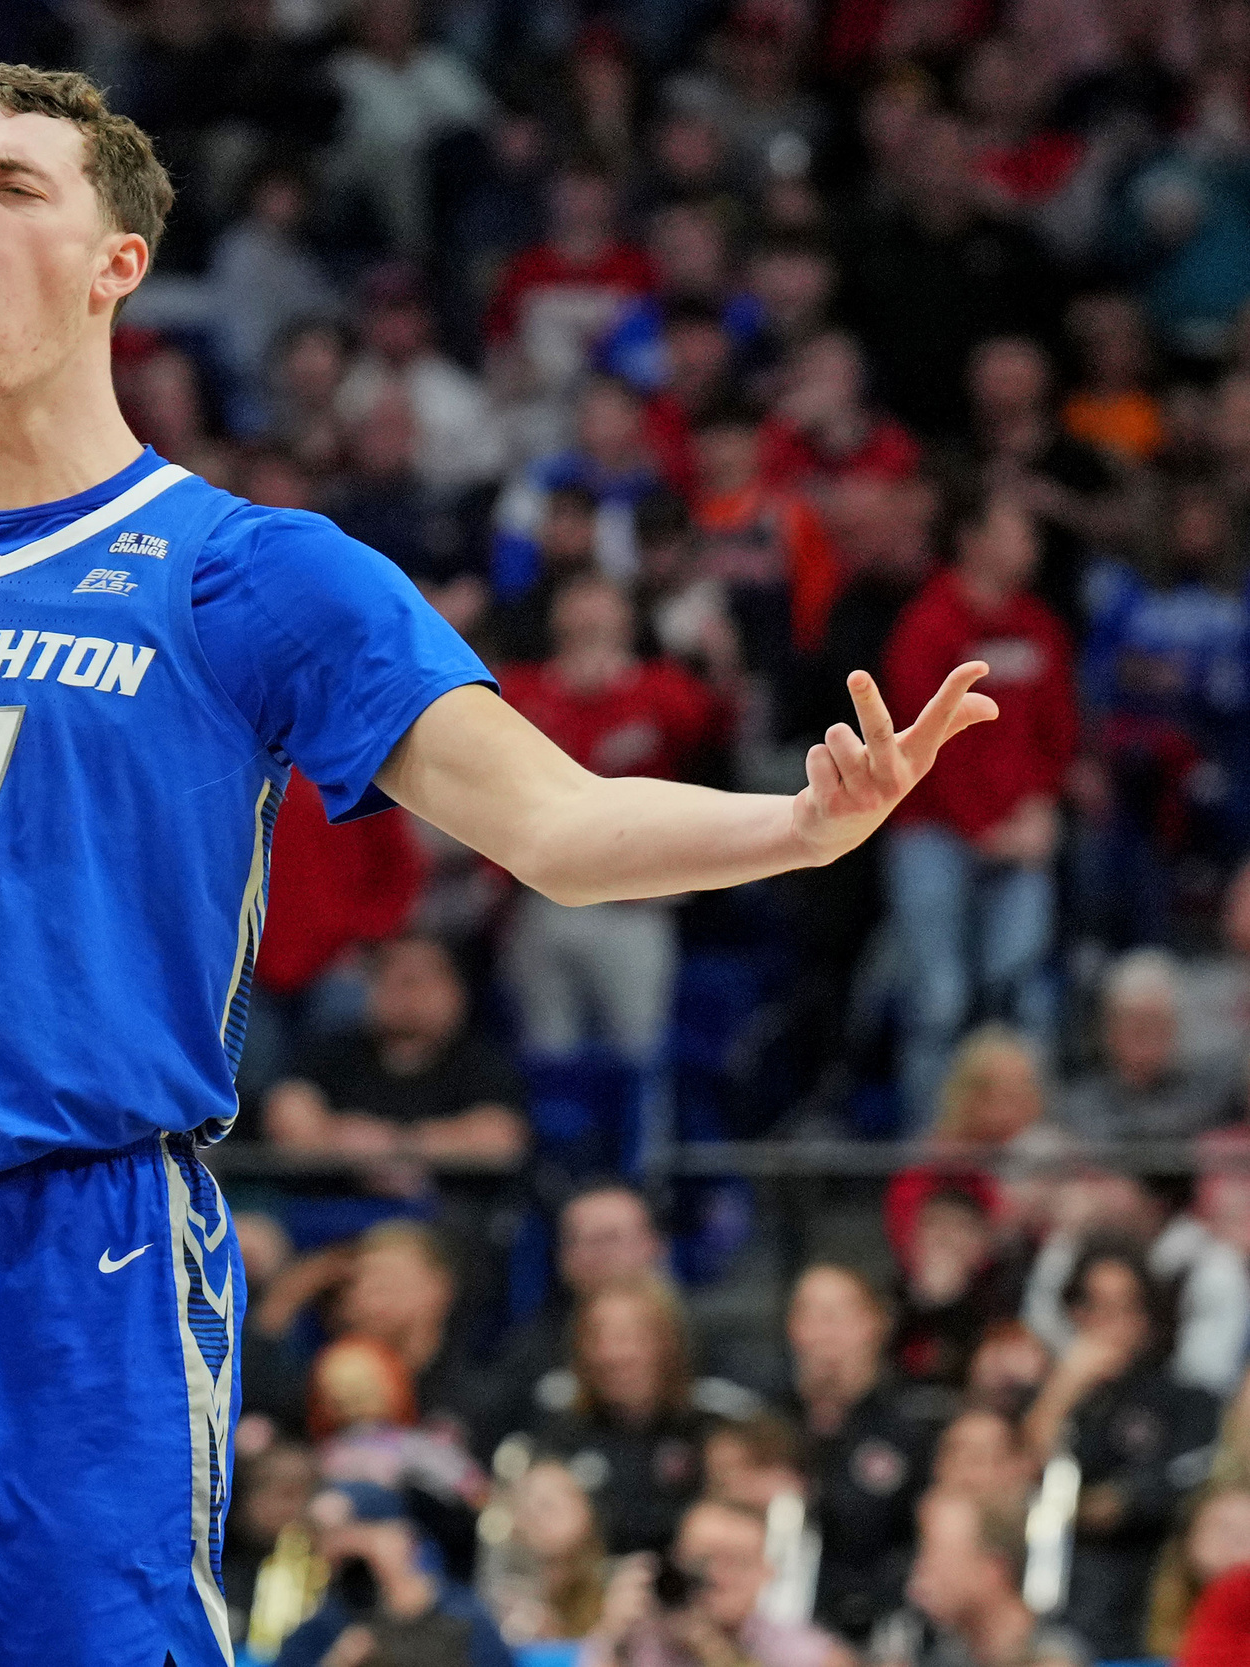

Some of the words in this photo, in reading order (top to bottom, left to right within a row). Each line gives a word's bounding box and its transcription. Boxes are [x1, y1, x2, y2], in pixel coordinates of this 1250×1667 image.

[117, 532, 139, 544] BE
[141, 534, 169, 549] THE
[109, 542, 168, 560] CHANGE
[85, 568, 131, 581] BIG
[76, 579, 139, 593] EAST
